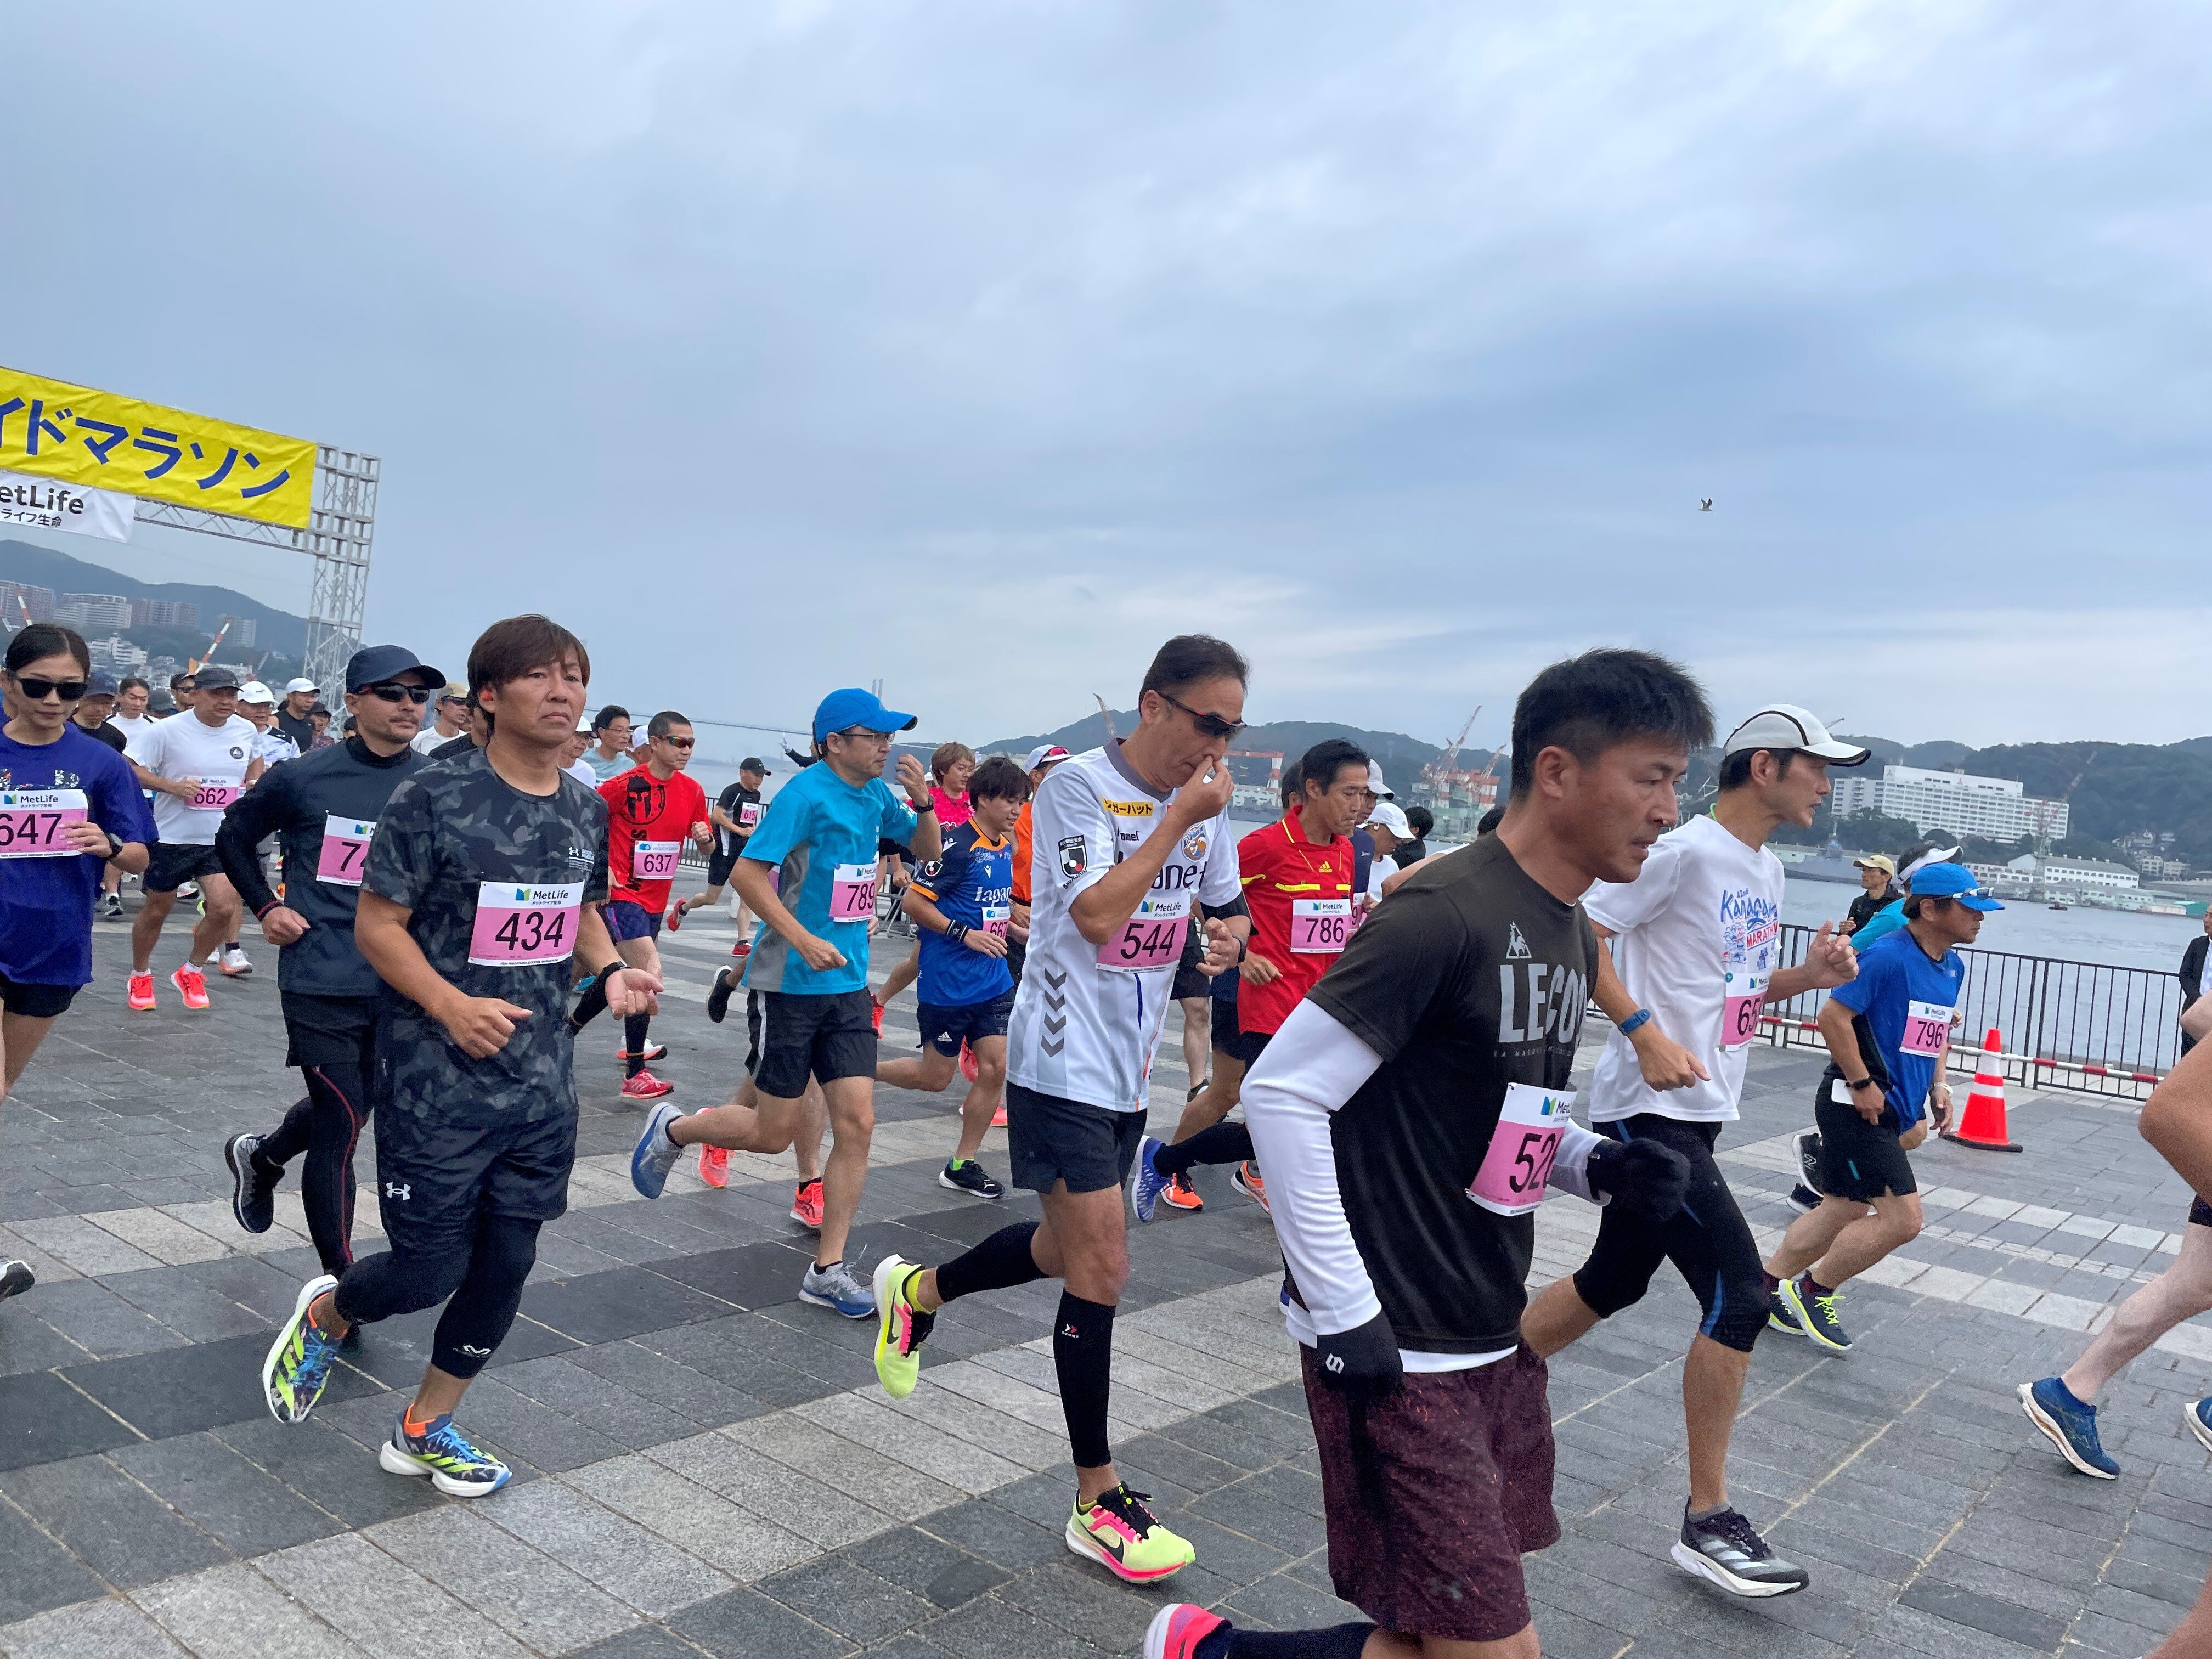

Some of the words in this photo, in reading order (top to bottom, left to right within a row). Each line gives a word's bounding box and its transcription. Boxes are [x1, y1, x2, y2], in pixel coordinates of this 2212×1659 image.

[1, 508, 62, 527] ライフ生命
[194, 788, 227, 804] 662
[744, 809, 756, 820] 615
[0, 813, 62, 846] 647
[340, 841, 365, 871] 7
[644, 854, 672, 872] 637
[533, 890, 568, 899] MetLife
[847, 882, 875, 911] 789
[1155, 902, 1181, 912] MetLife
[495, 912, 566, 951] 434
[990, 922, 1008, 940] 667
[1121, 922, 1177, 960] 544
[1306, 917, 1344, 943] 786
[1916, 1020, 1944, 1048] 796
